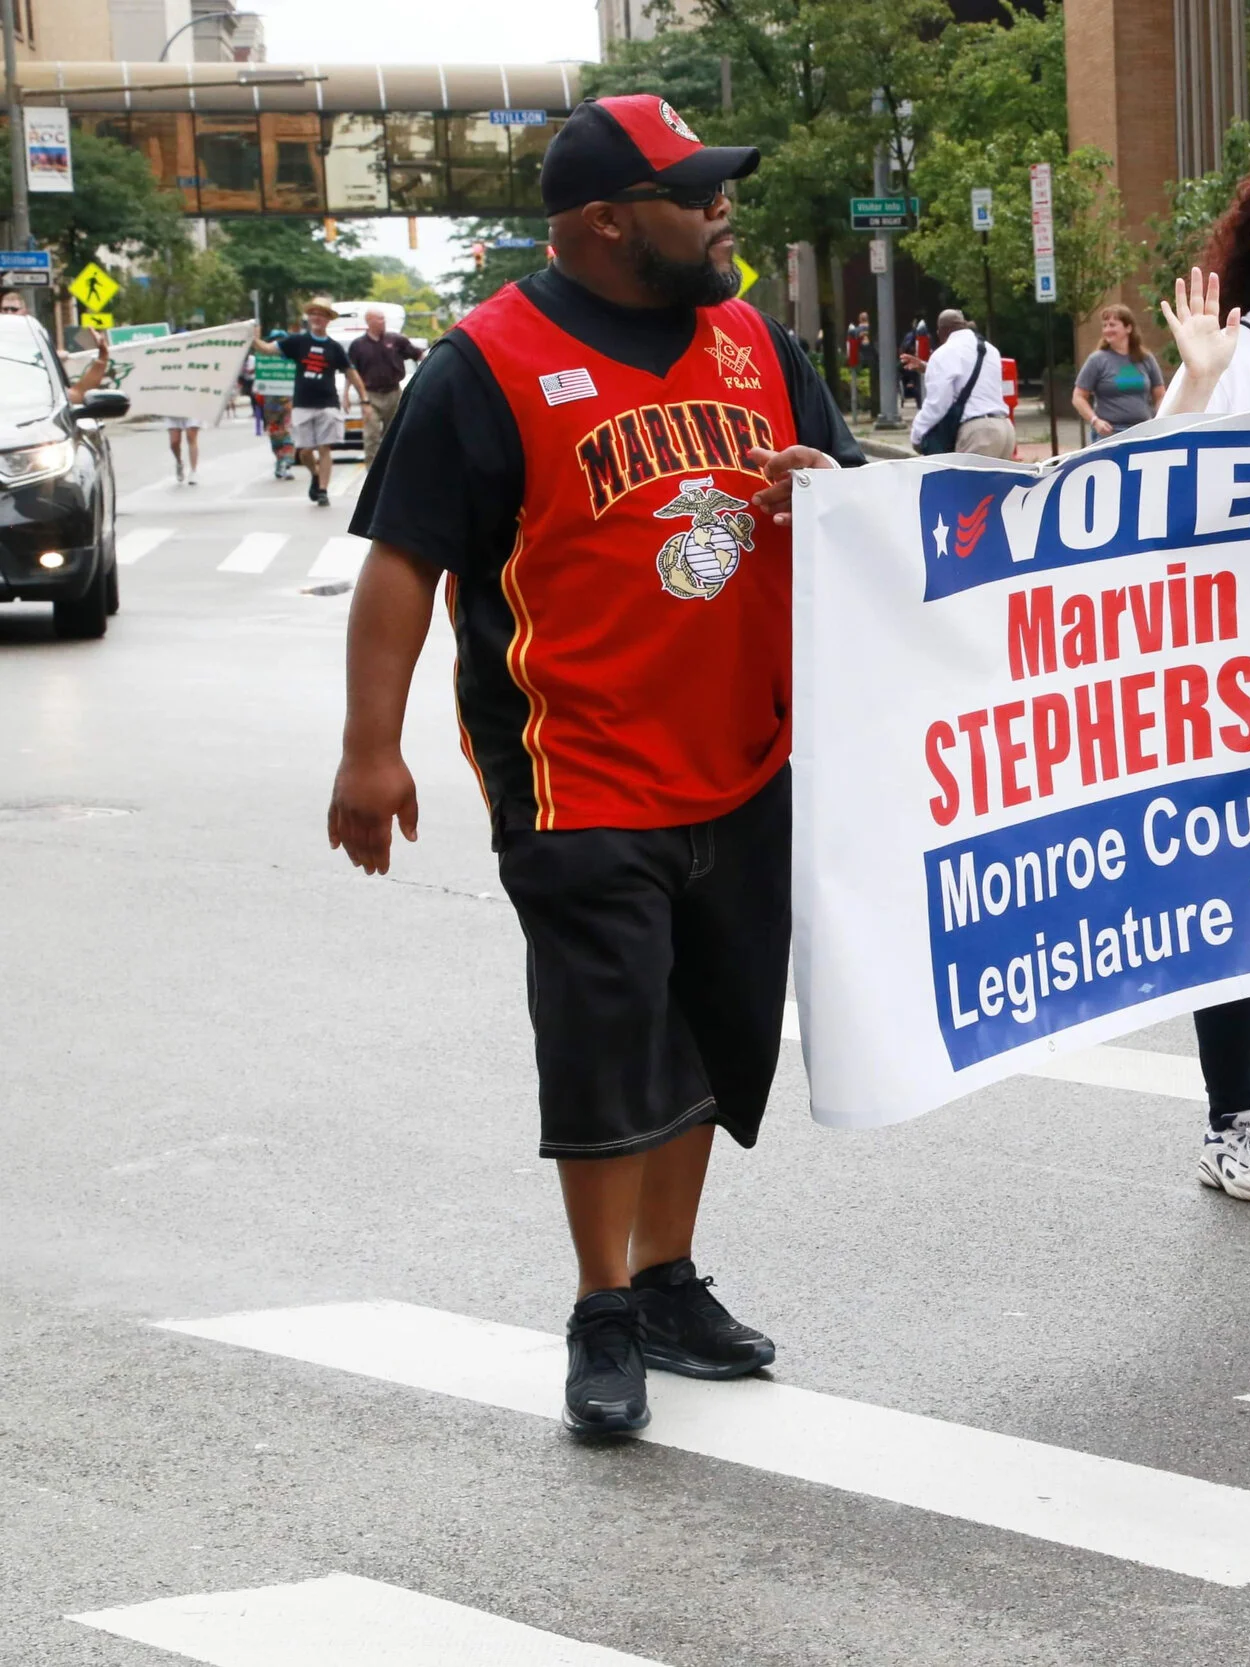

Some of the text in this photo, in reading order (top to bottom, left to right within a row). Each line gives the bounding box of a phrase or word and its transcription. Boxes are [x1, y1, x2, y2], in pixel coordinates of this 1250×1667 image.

[493, 111, 543, 123] STILLSON
[857, 203, 901, 212] Visitor Info
[869, 217, 901, 226] ON RIGHT
[186, 338, 247, 350] Rochester
[723, 345, 736, 357] G
[724, 376, 762, 390] F&AM
[1007, 562, 1239, 681] Marvin
[939, 828, 1126, 933] Monroe
[947, 898, 1233, 1030] Legislature
